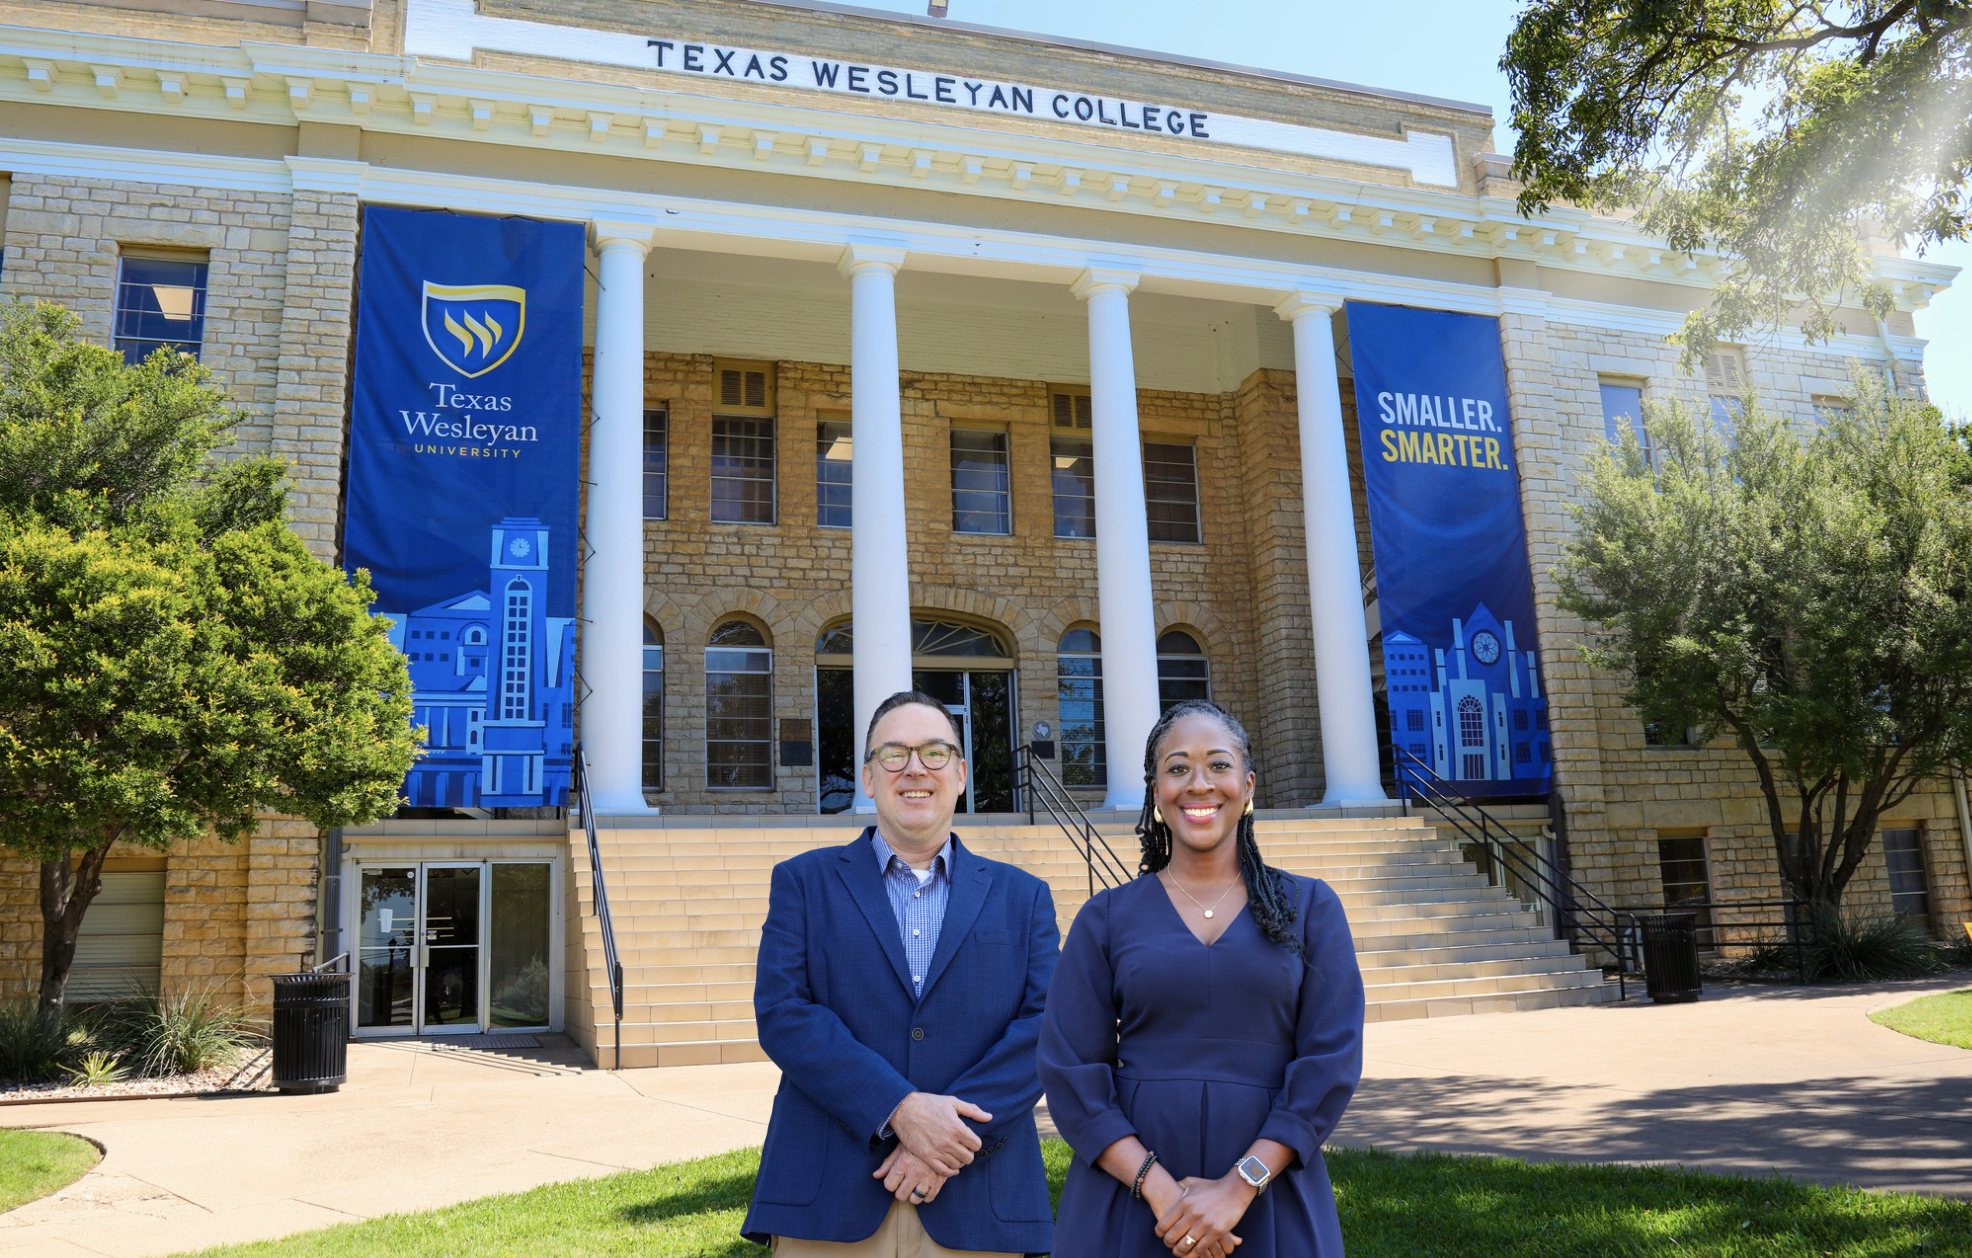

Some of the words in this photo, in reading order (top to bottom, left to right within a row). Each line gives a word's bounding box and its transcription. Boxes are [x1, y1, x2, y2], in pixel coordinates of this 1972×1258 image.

[647, 41, 788, 82] TEXAS
[812, 61, 1033, 113] WESLEYAN
[1052, 94, 1210, 138] COLLEGE
[429, 382, 512, 411] Texas
[1377, 391, 1503, 433] SMALLER.
[399, 410, 539, 446] Wesleyan
[414, 444, 521, 459] UNIVERSITY
[1380, 428, 1509, 471] SMARTER.
